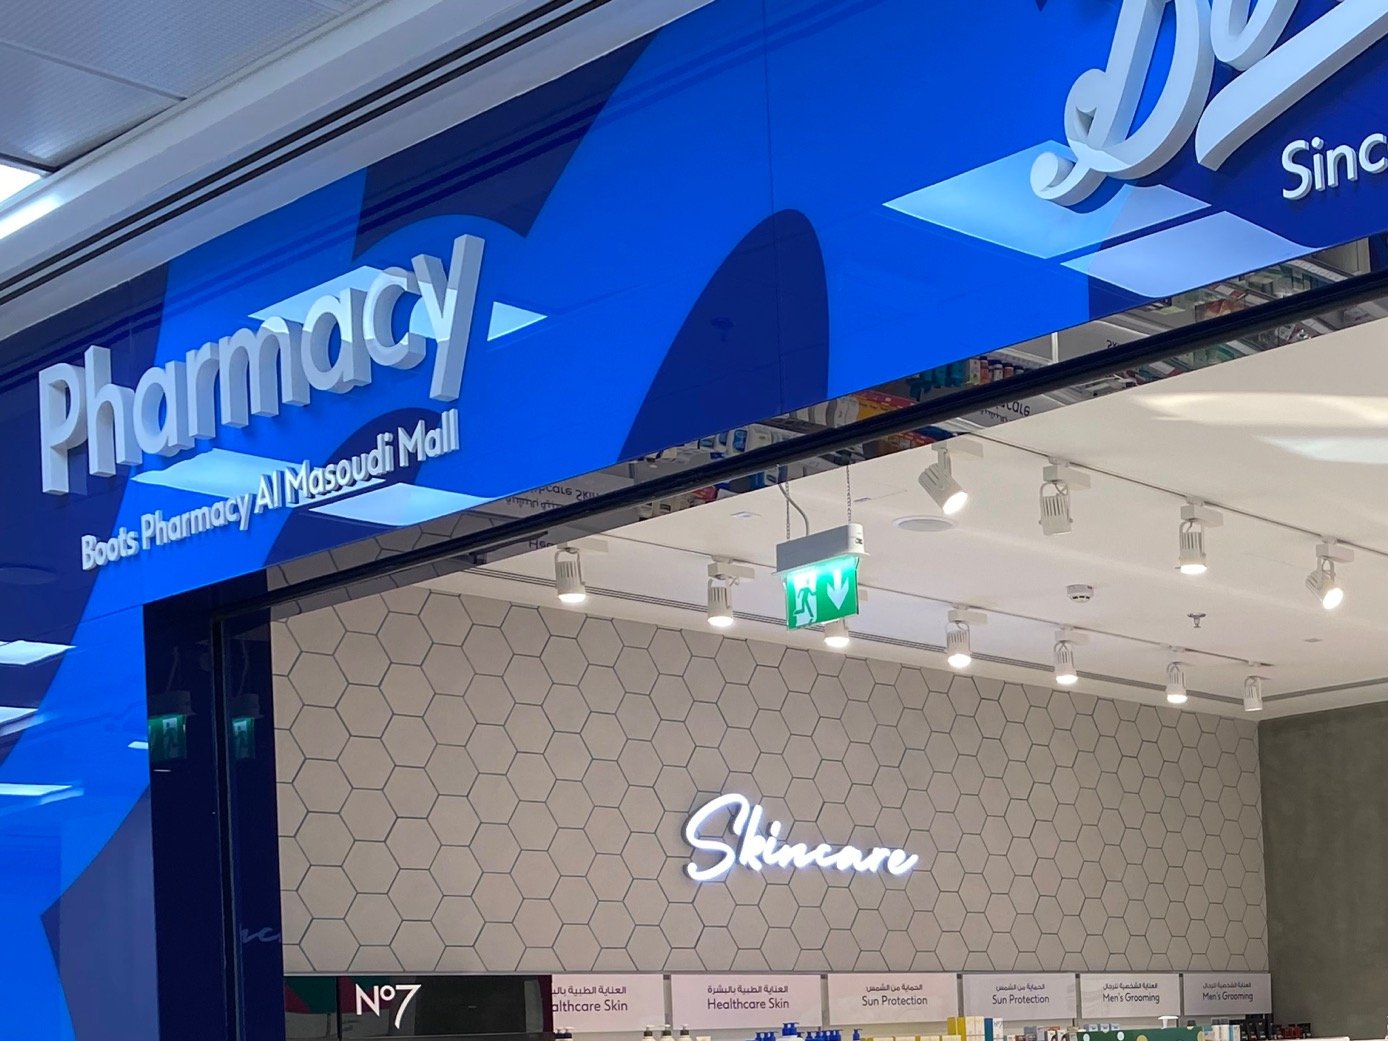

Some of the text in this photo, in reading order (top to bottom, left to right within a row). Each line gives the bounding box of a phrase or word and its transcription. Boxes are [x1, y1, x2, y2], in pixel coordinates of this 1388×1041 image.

[38, 233, 486, 495] Pharmacy
[81, 408, 460, 571] Boots Pharmacy Al Masoudi Mall
[685, 792, 920, 884] Skincare
[598, 985, 627, 995] العناية
[763, 984, 788, 994] العناية
[861, 994, 928, 1006] Sun Protection
[992, 994, 1050, 1005] Sun Protection
[1102, 993, 1160, 1004] Men's Grooming
[1202, 992, 1254, 1002] Men's Grooming
[551, 999, 628, 1012] althcare Skin
[706, 997, 790, 1010] Healthcare Skin
